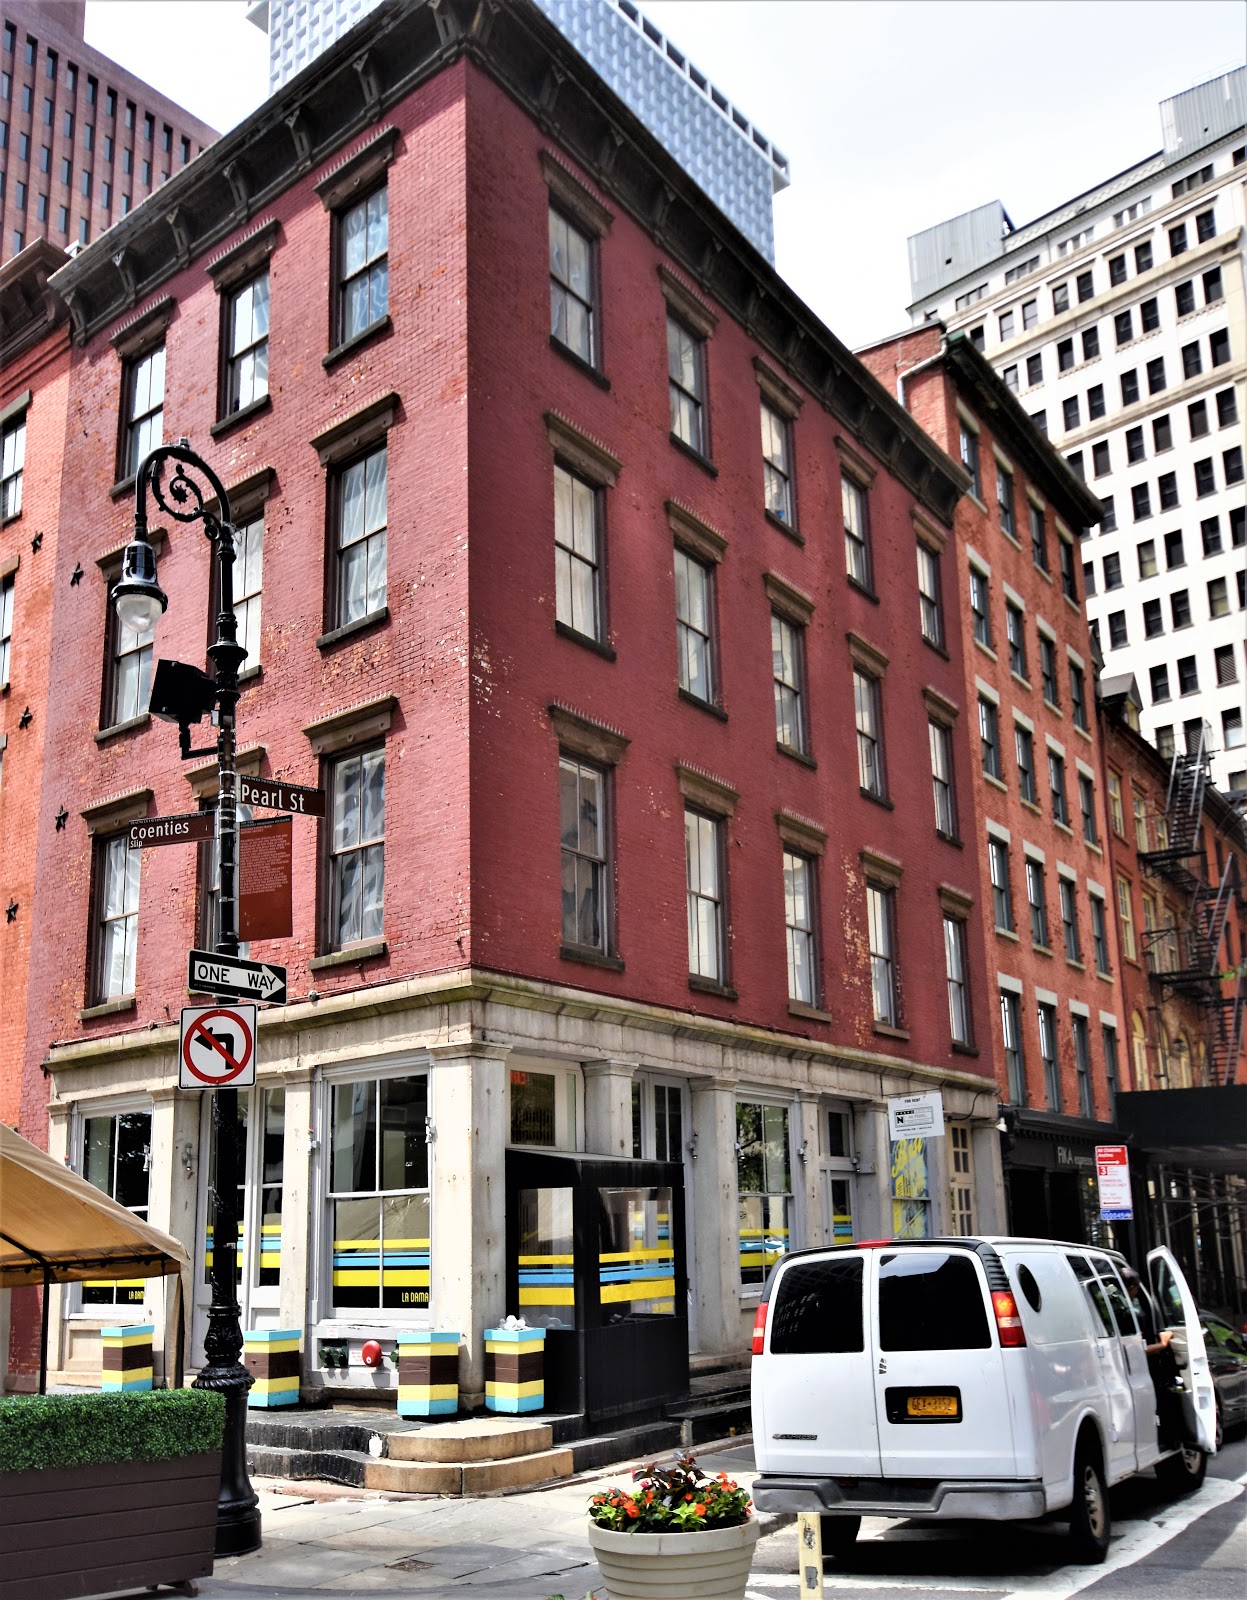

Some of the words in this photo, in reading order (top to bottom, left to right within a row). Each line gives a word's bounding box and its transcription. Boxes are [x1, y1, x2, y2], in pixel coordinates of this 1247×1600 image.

[241, 783, 283, 808] Pearl
[289, 792, 305, 812] St
[130, 821, 190, 841] Coenties
[130, 839, 143, 849] Slip
[198, 964, 230, 983] ONE
[247, 972, 276, 990] WAY
[1100, 1166, 1107, 1175] 3
[128, 1290, 135, 1300] LA
[134, 1290, 145, 1300] DAM
[401, 1291, 410, 1303] LA
[410, 1291, 429, 1303] DAMA
